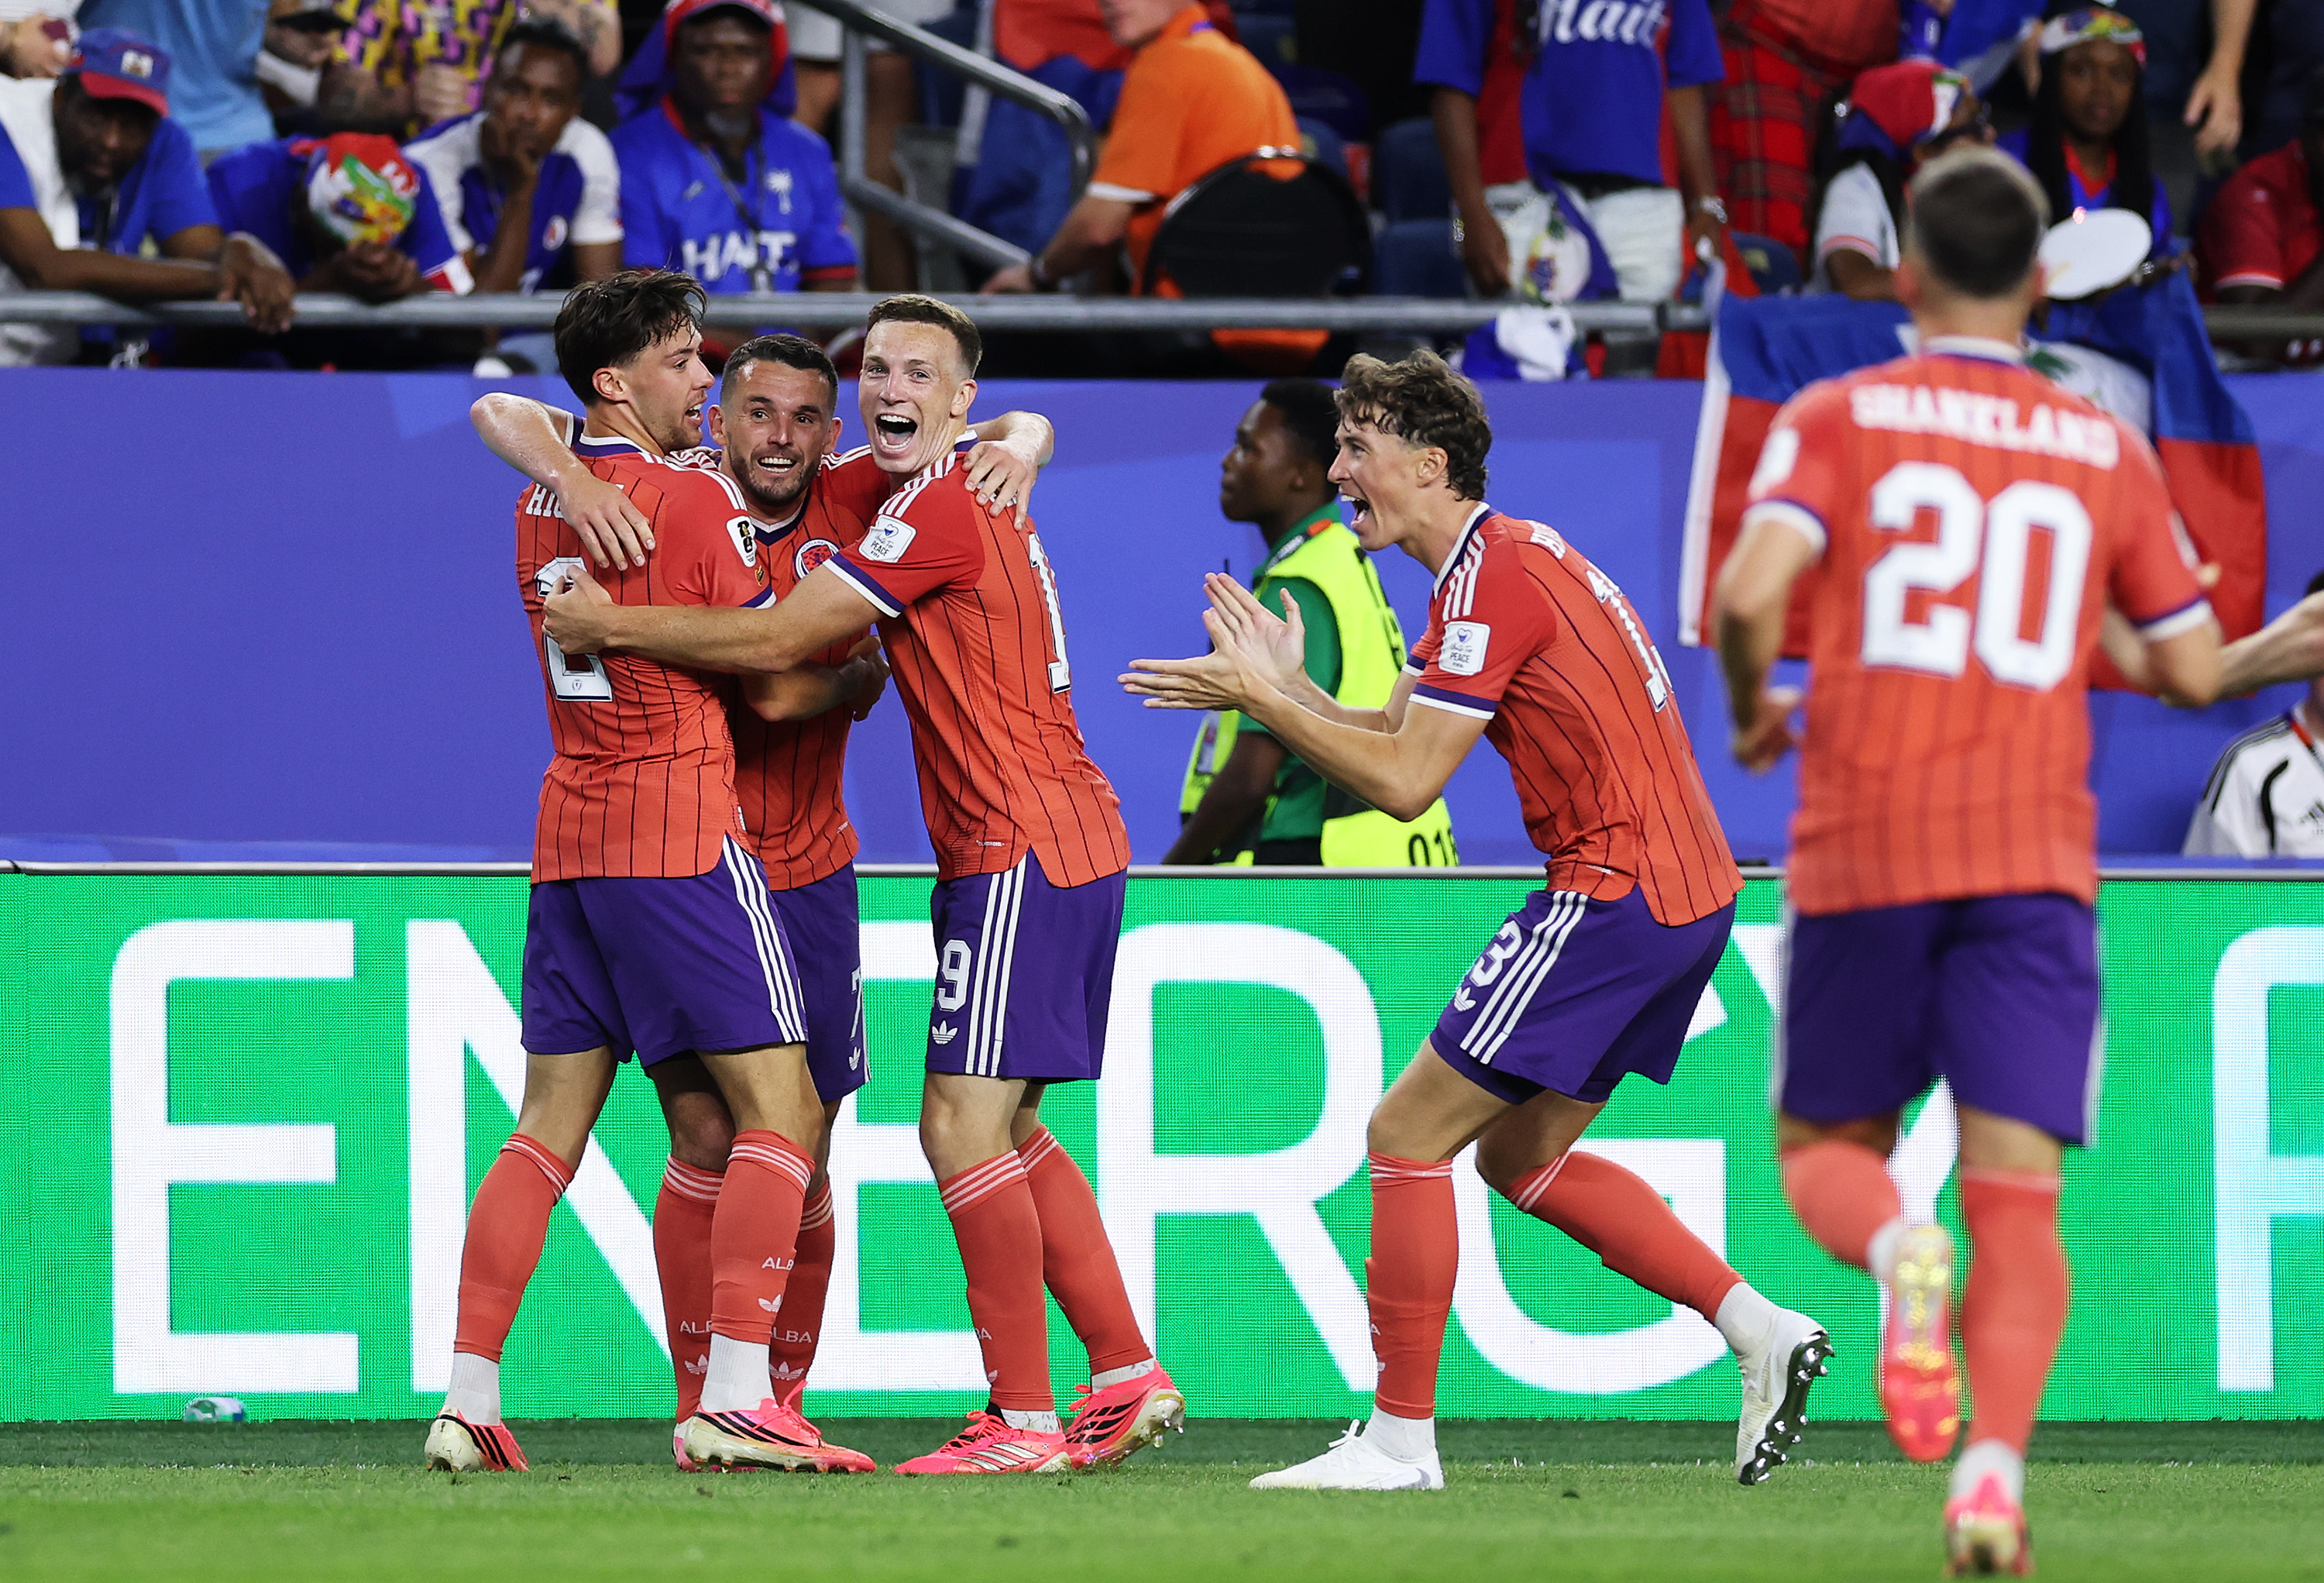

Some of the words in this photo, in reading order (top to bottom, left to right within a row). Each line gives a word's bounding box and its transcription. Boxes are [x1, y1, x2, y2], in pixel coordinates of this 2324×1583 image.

[1861, 460, 2093, 693] 20
[1028, 532, 1071, 694] 1
[1470, 920, 1522, 987] 3
[761, 1256, 795, 1271] ALB
[772, 1327, 813, 1344] LBA
